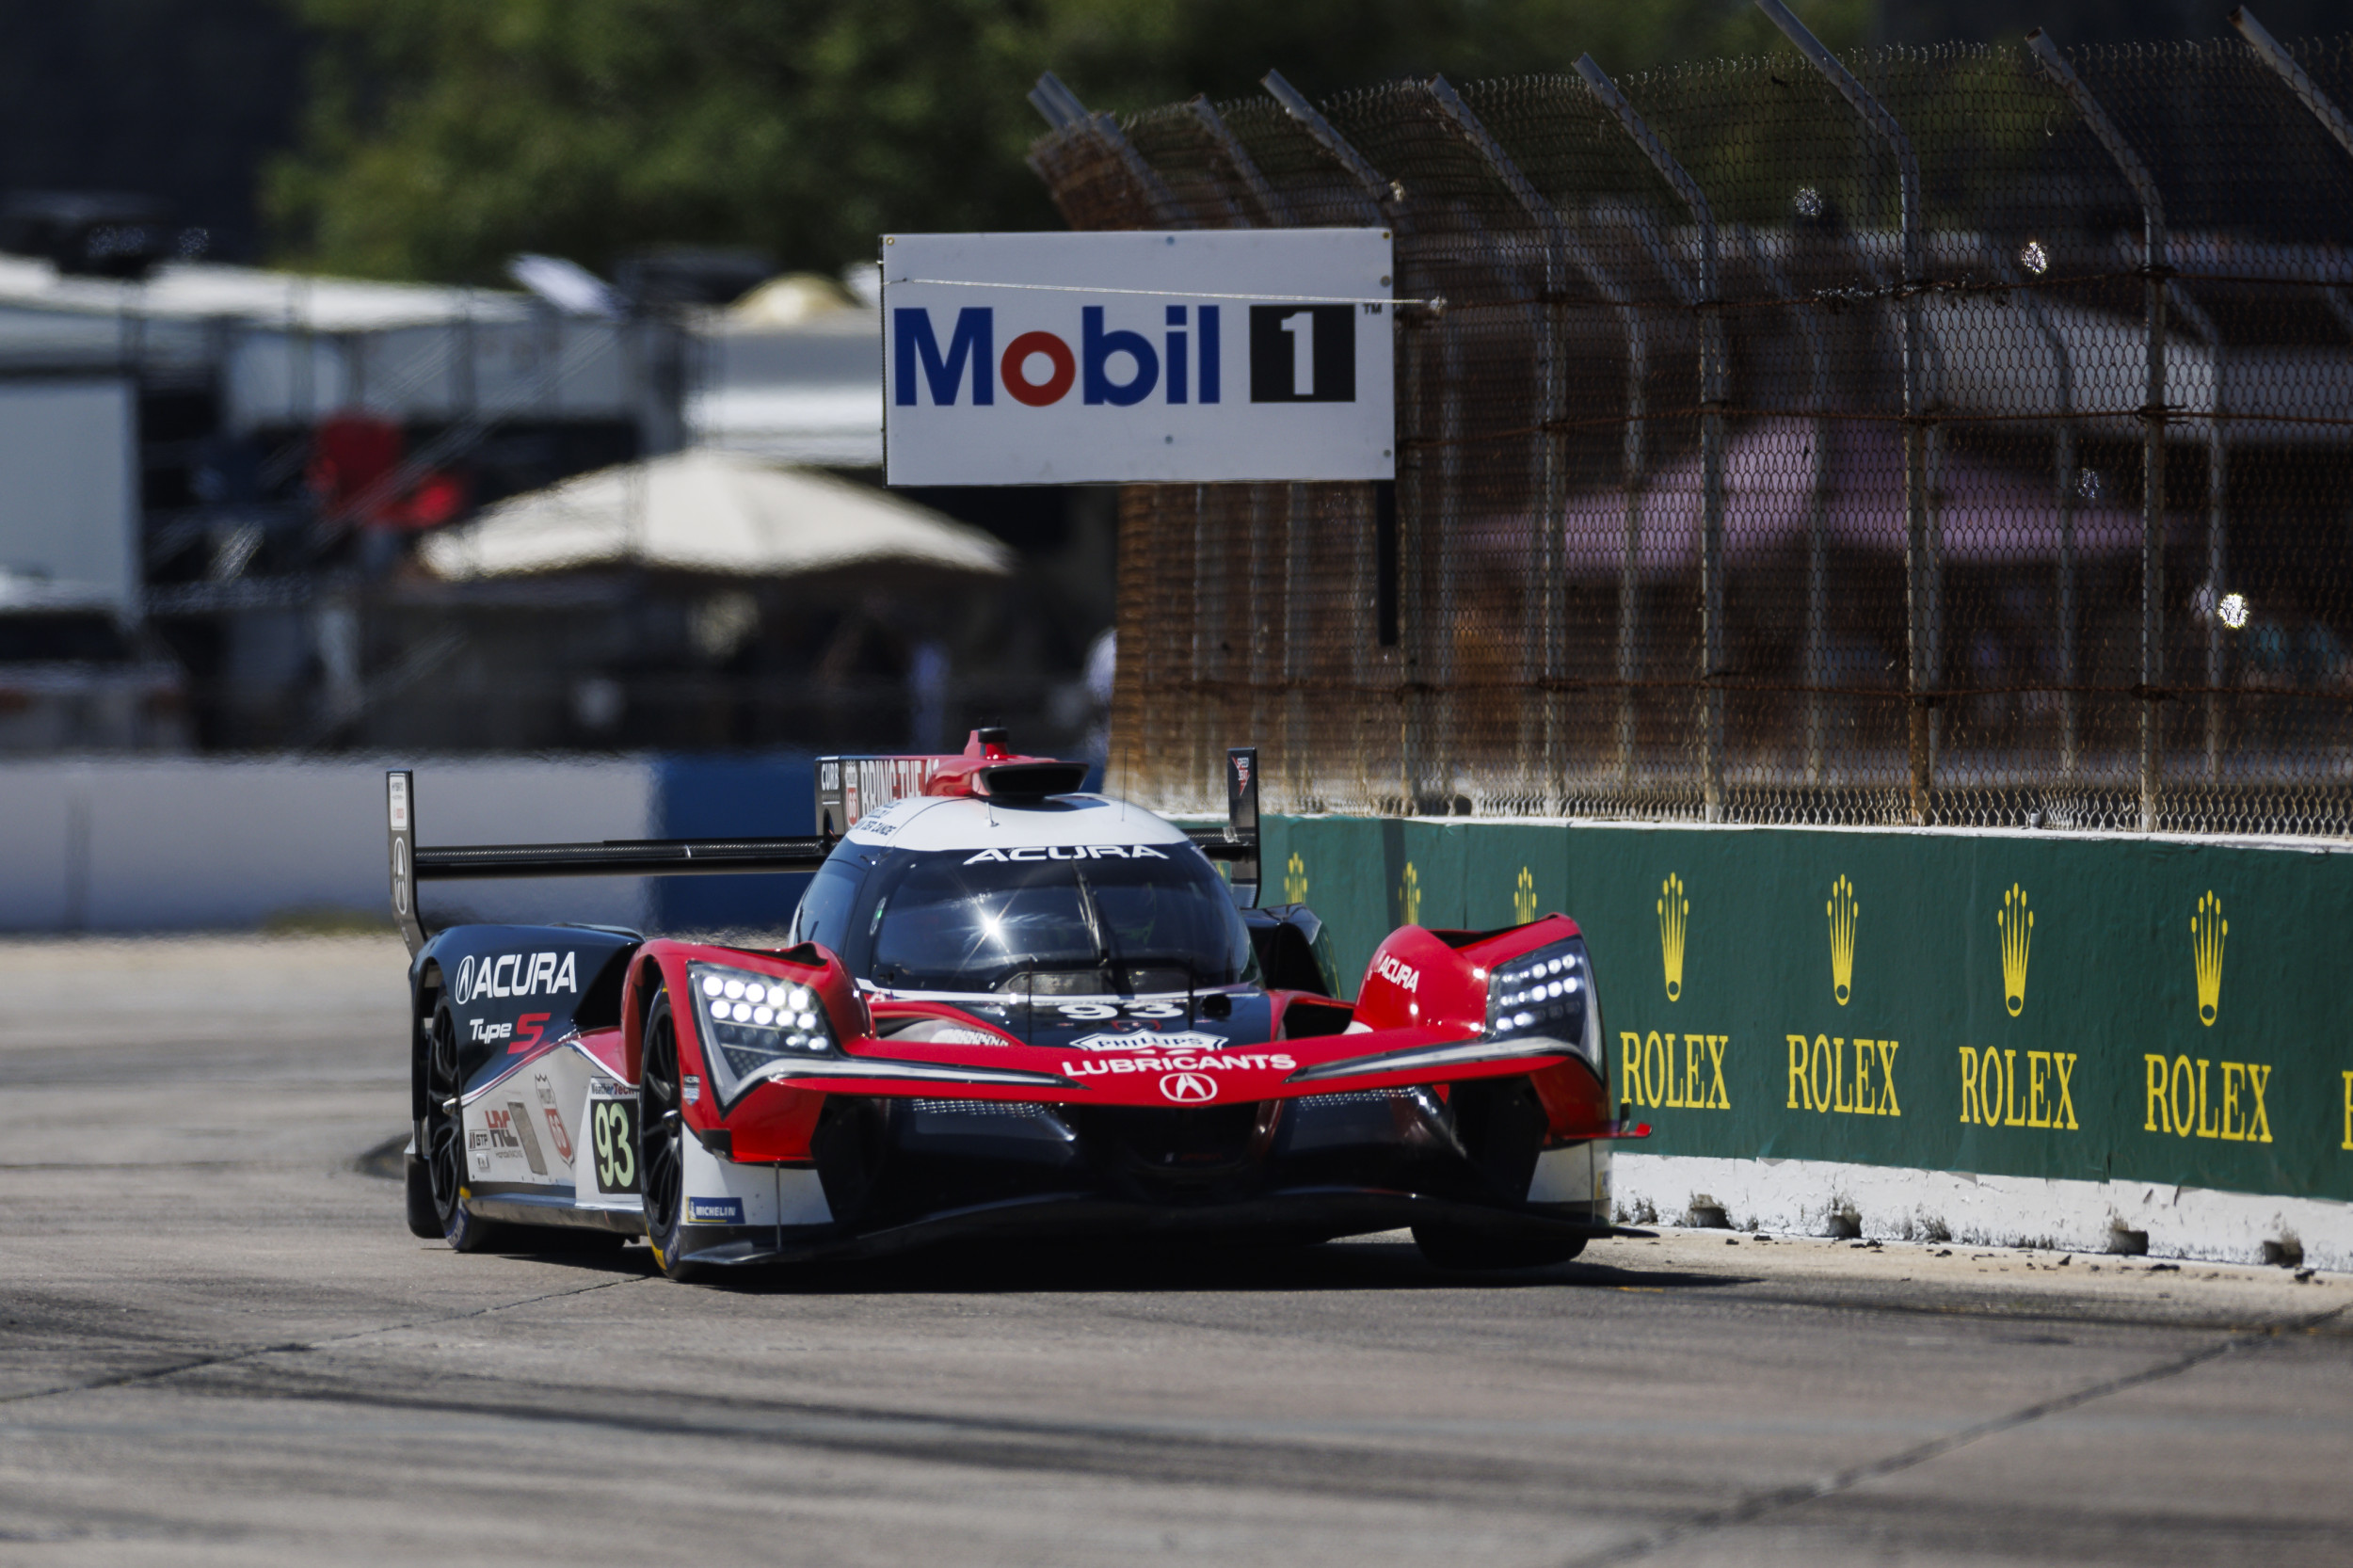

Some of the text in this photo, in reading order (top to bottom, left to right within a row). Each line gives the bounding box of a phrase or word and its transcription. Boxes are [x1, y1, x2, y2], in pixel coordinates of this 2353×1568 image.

[893, 305, 1220, 407] Mobil
[1280, 311, 1314, 395] 1
[821, 762, 840, 791] CURB
[963, 845, 1170, 866] ACURA
[472, 951, 577, 1000] ACURA
[1377, 954, 1419, 994] ACURA
[1058, 1001, 1184, 1020] 93
[470, 1012, 552, 1054] Type S
[1096, 1035, 1205, 1048] PHILLIPS
[1061, 1053, 1297, 1077] LUBRICANTS
[1619, 1031, 1731, 1110] ROLEX
[1786, 1033, 1901, 1117] ROLEX
[1959, 1046, 2079, 1130] ROLEX
[2144, 1054, 2273, 1144] ROLEX
[475, 1133, 488, 1146] GTP
[595, 1102, 634, 1188] 93
[696, 1206, 736, 1217] MICHELIN
